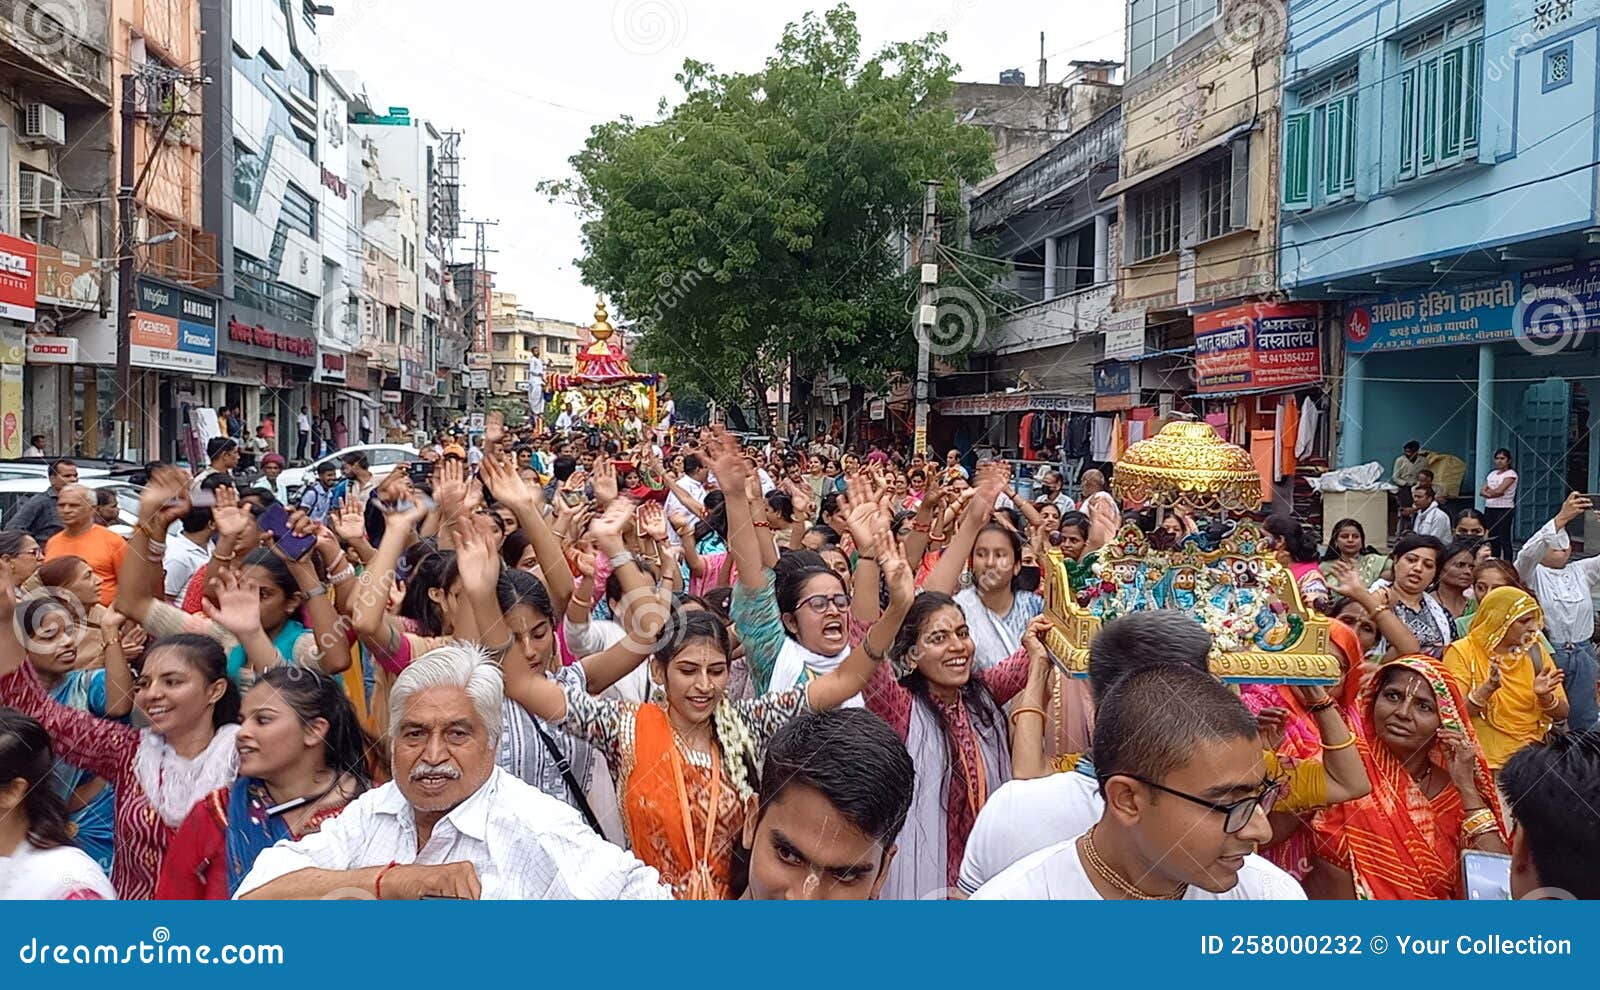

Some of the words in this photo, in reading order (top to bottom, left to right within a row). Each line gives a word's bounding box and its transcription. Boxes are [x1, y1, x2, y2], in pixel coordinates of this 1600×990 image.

[183, 299, 213, 319] SAMSUNG
[1371, 298, 1415, 323] अशोक
[1418, 291, 1456, 322] ट्रेडिंग
[1459, 280, 1515, 311] कम्पनी
[1257, 331, 1315, 349] वस्त्रालय
